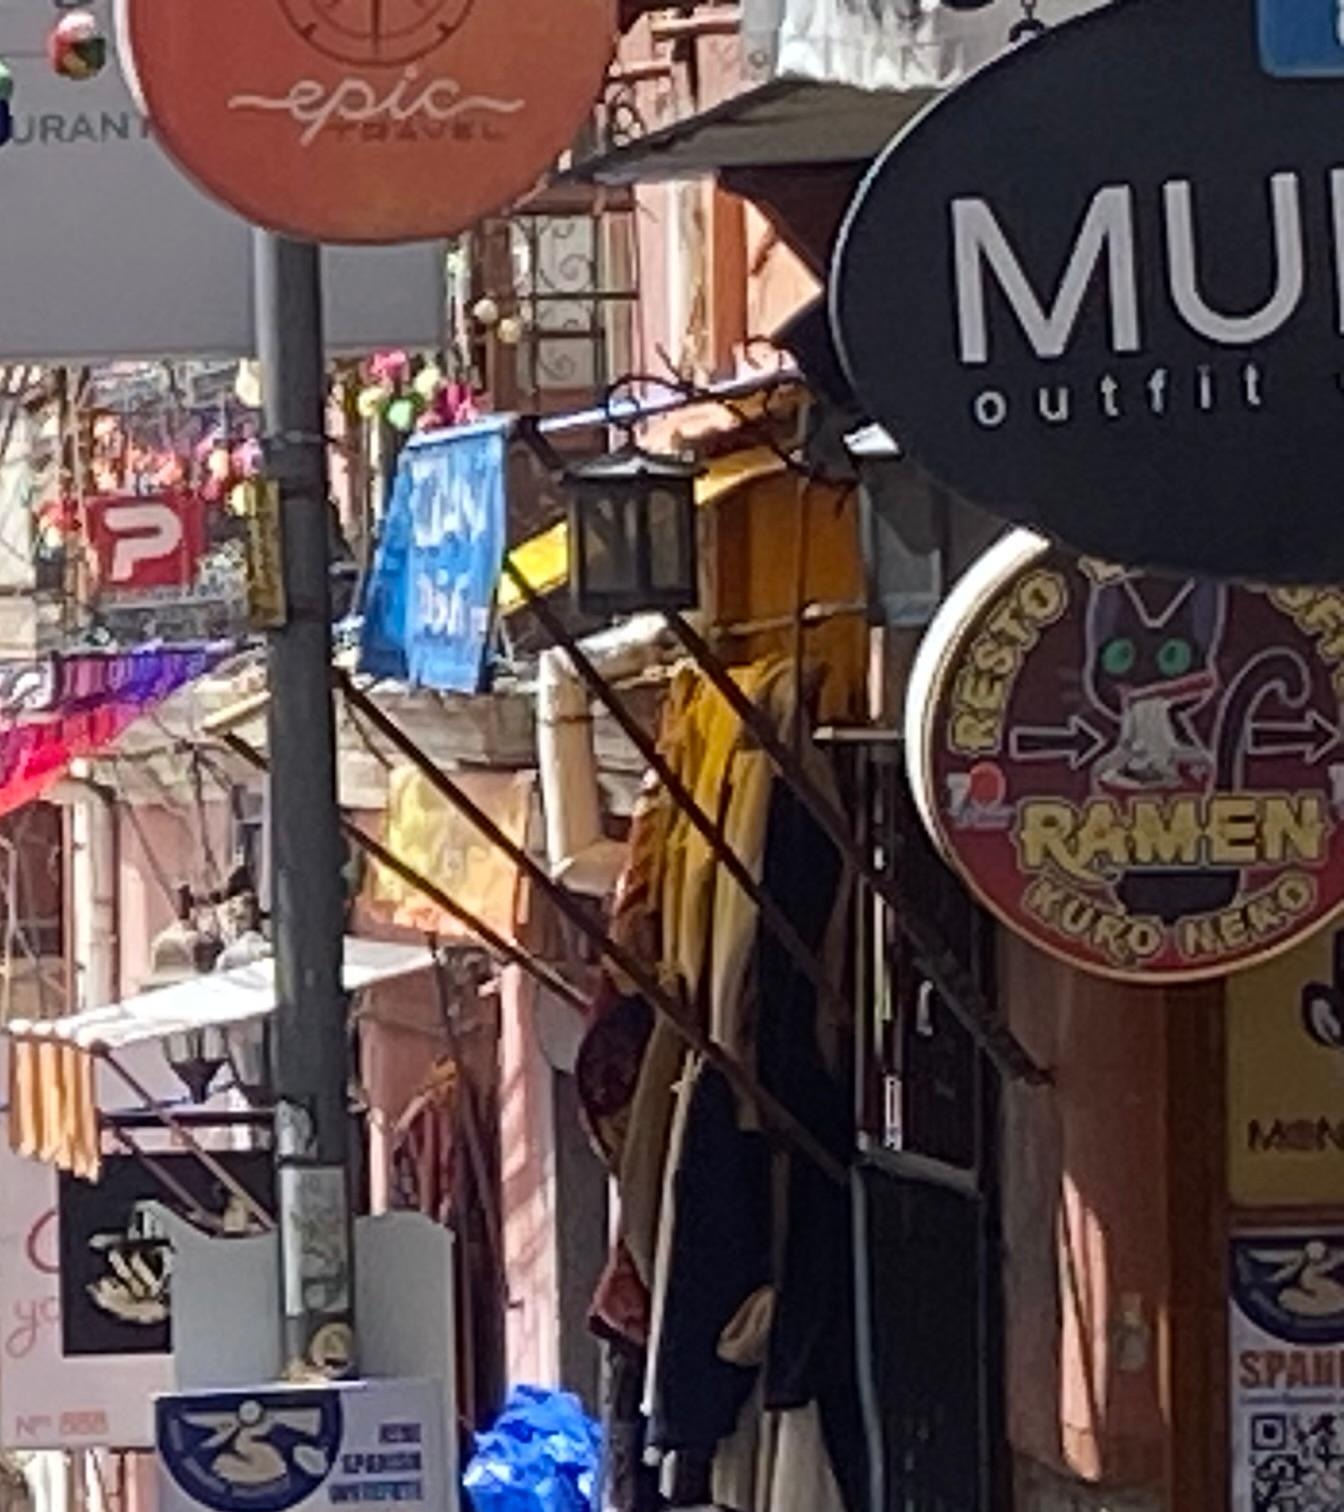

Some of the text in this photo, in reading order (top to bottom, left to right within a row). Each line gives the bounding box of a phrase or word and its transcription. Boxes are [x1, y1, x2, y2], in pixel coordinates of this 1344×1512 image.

[228, 64, 525, 147] epic
[950, 168, 1344, 362] MU
[974, 364, 1262, 427] outfit
[954, 574, 1064, 752] RESTO
[1021, 798, 1322, 882] RAMEN
